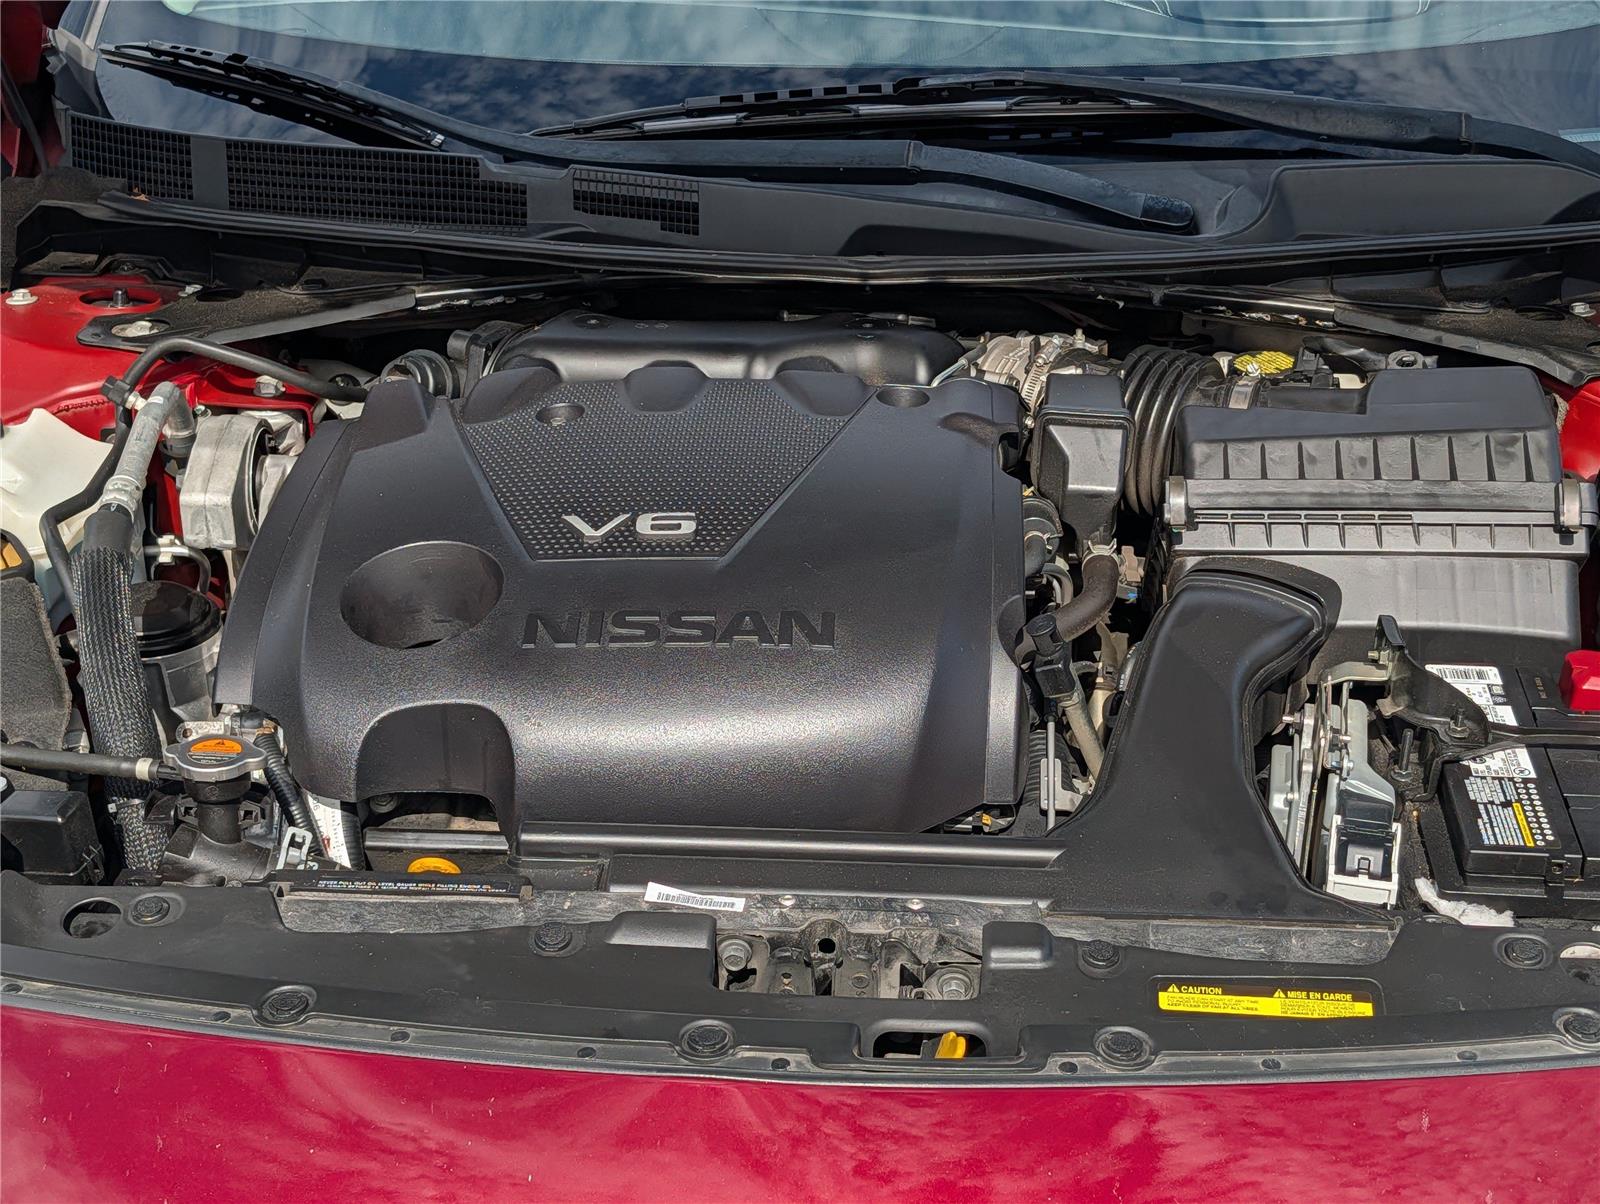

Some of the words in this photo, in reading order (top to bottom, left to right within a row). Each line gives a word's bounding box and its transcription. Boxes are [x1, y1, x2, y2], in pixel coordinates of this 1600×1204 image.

[561, 511, 697, 542] V6
[521, 609, 836, 649] NISSAN
[1181, 985, 1222, 995] CAUTION
[1287, 990, 1308, 999] MISE
[1309, 991, 1321, 1000] EN
[1322, 993, 1353, 1001] GARDE
